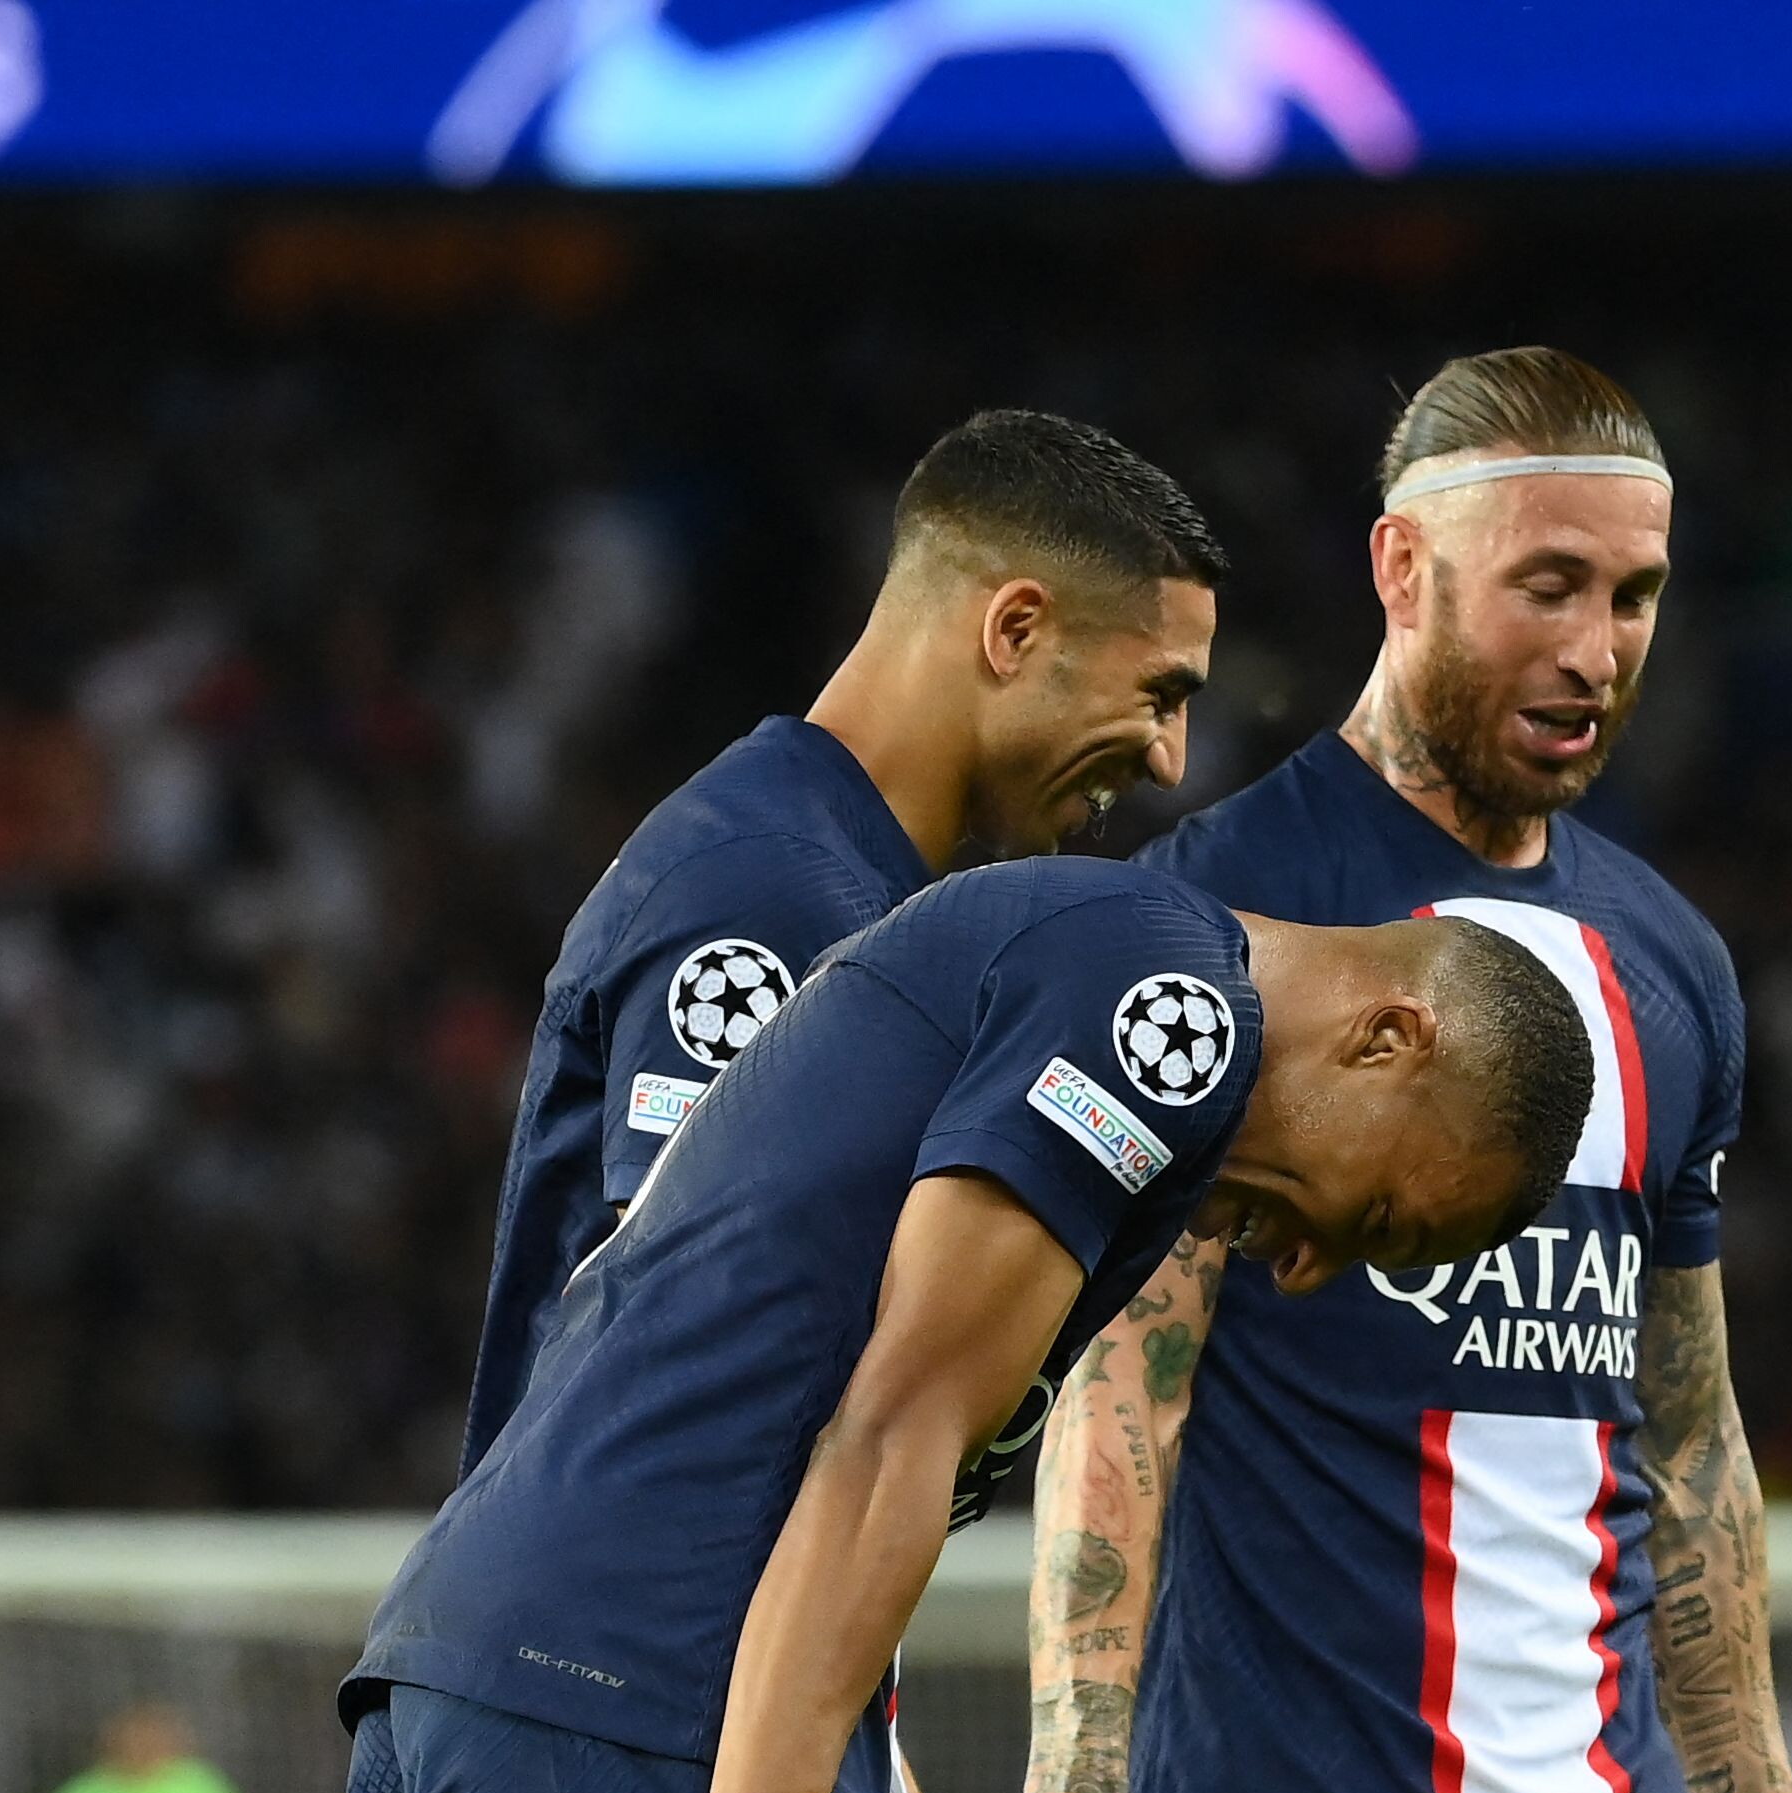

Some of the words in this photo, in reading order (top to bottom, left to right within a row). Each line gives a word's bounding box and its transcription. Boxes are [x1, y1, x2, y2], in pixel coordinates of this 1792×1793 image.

[637, 1079, 672, 1093] UEFA
[1053, 1063, 1087, 1092] UEFA
[1041, 1073, 1160, 1181] FOUNDATION
[1363, 1226, 1642, 1325] QATAR
[1452, 1315, 1638, 1379] AIRWAYS
